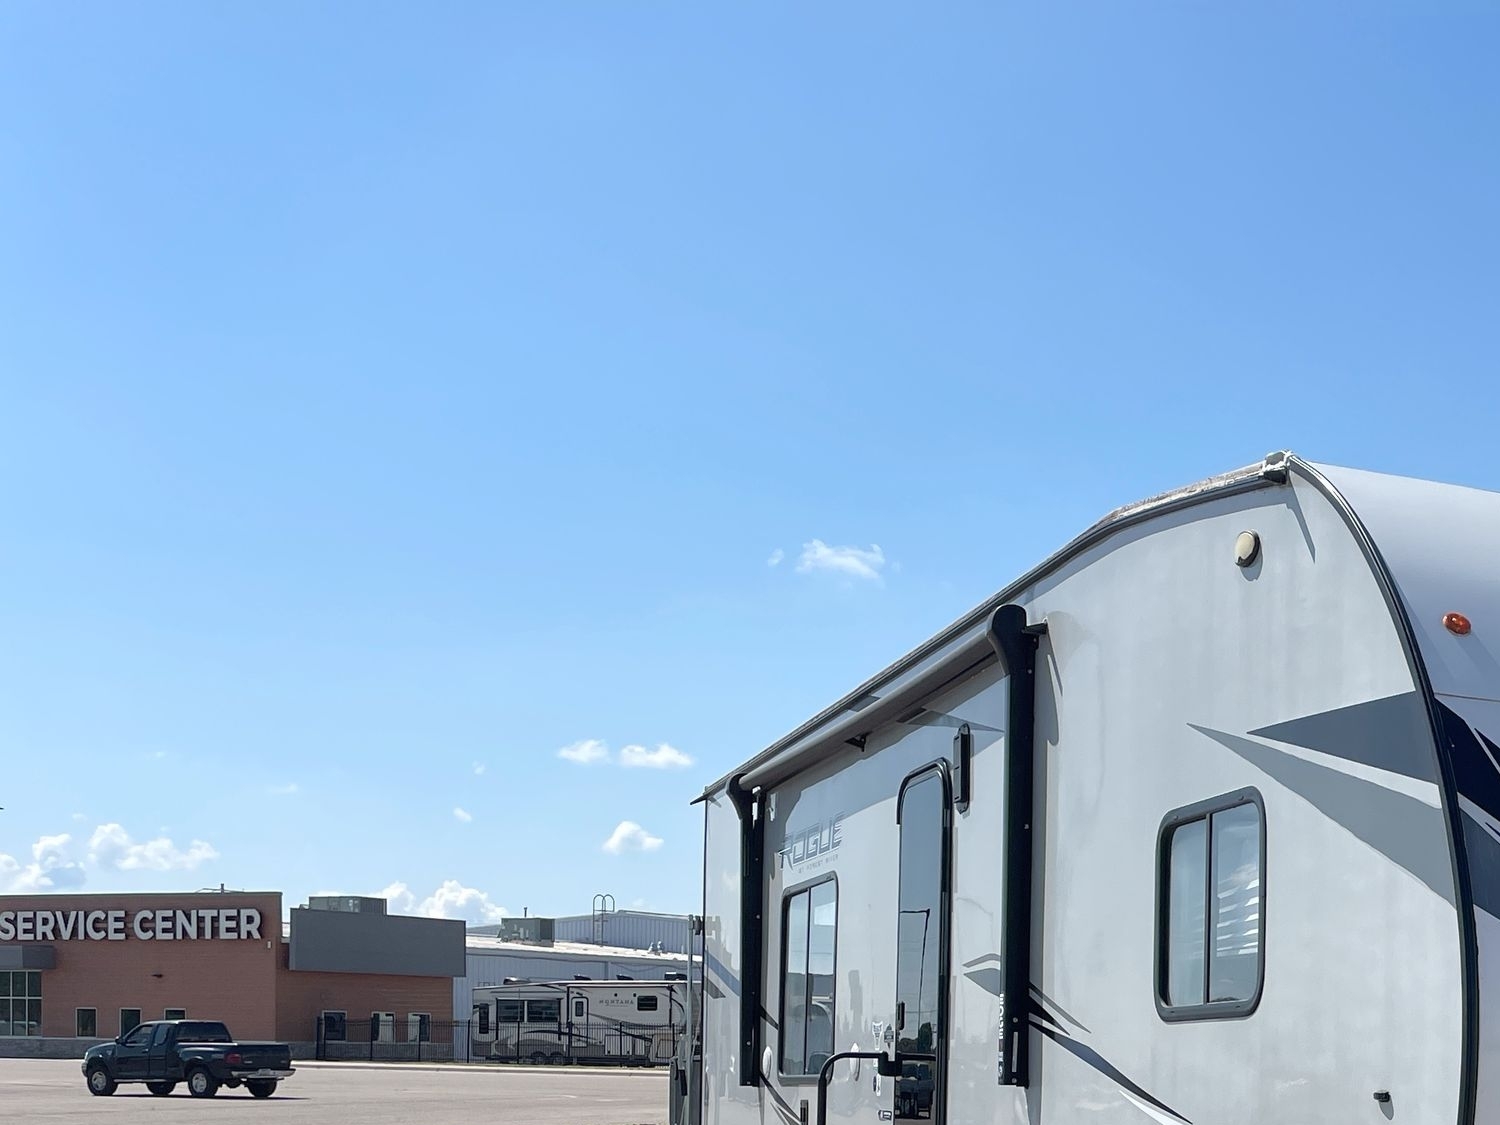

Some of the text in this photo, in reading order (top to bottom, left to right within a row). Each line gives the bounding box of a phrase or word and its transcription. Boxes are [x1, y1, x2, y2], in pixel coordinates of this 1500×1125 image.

[778, 810, 843, 871] ROGUE
[0, 908, 262, 941] SERVICE CENTER
